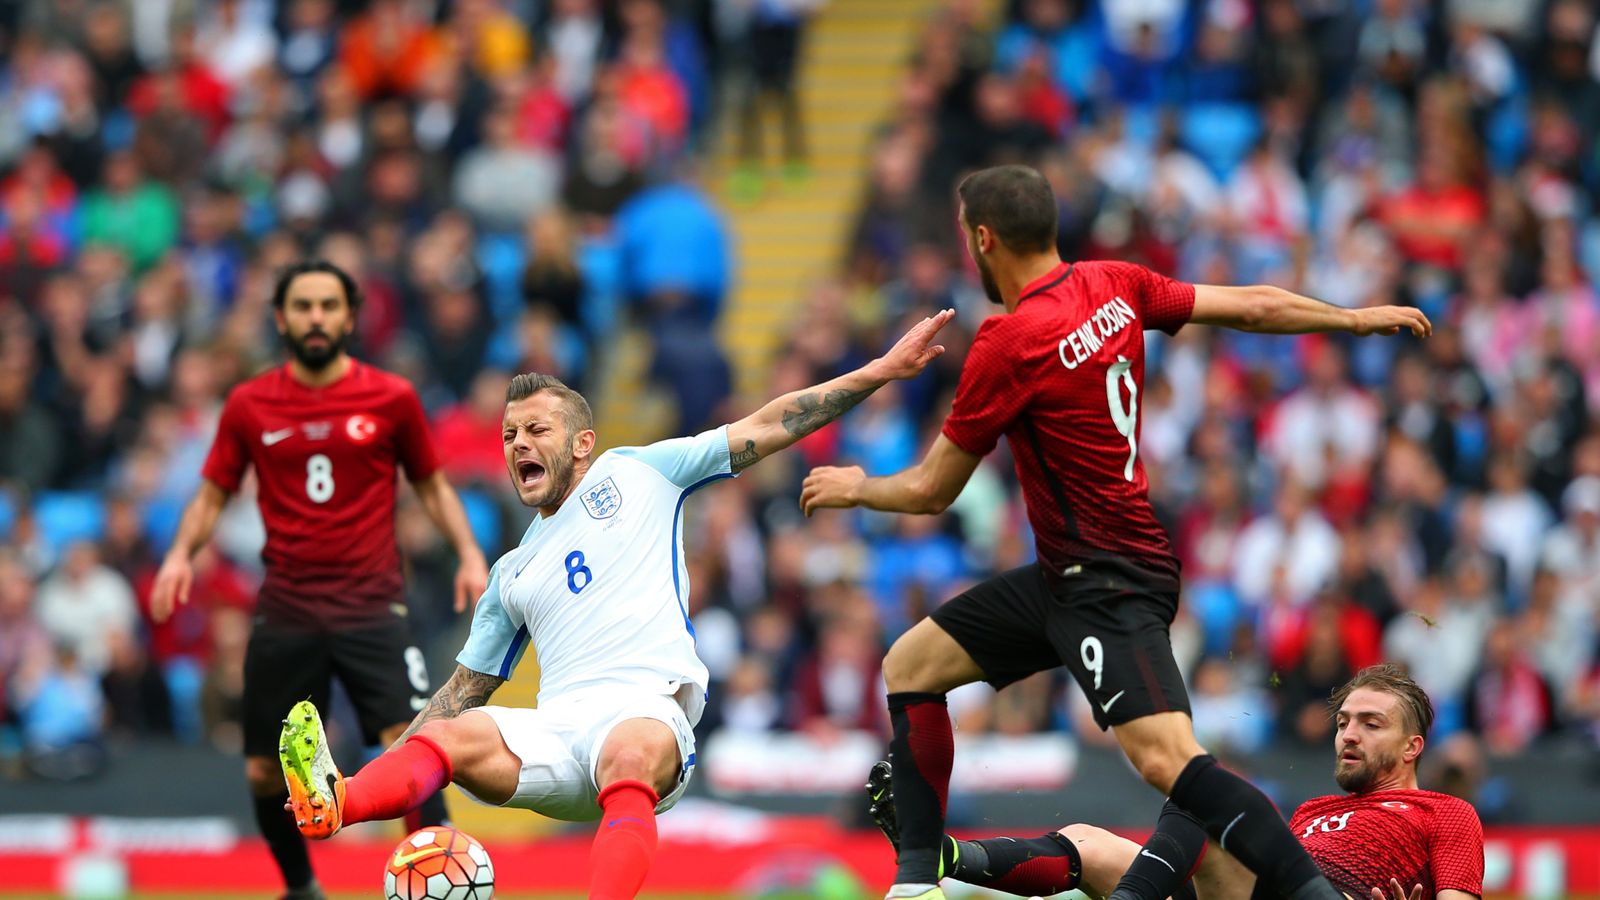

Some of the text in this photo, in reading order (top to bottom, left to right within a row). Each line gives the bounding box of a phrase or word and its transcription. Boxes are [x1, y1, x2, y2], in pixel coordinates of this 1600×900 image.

[1058, 321, 1104, 370] CENK
[1106, 354, 1138, 482] 9
[306, 453, 335, 504] 8
[564, 550, 593, 594] 8
[404, 646, 430, 692] 8
[1080, 635, 1104, 690] 9
